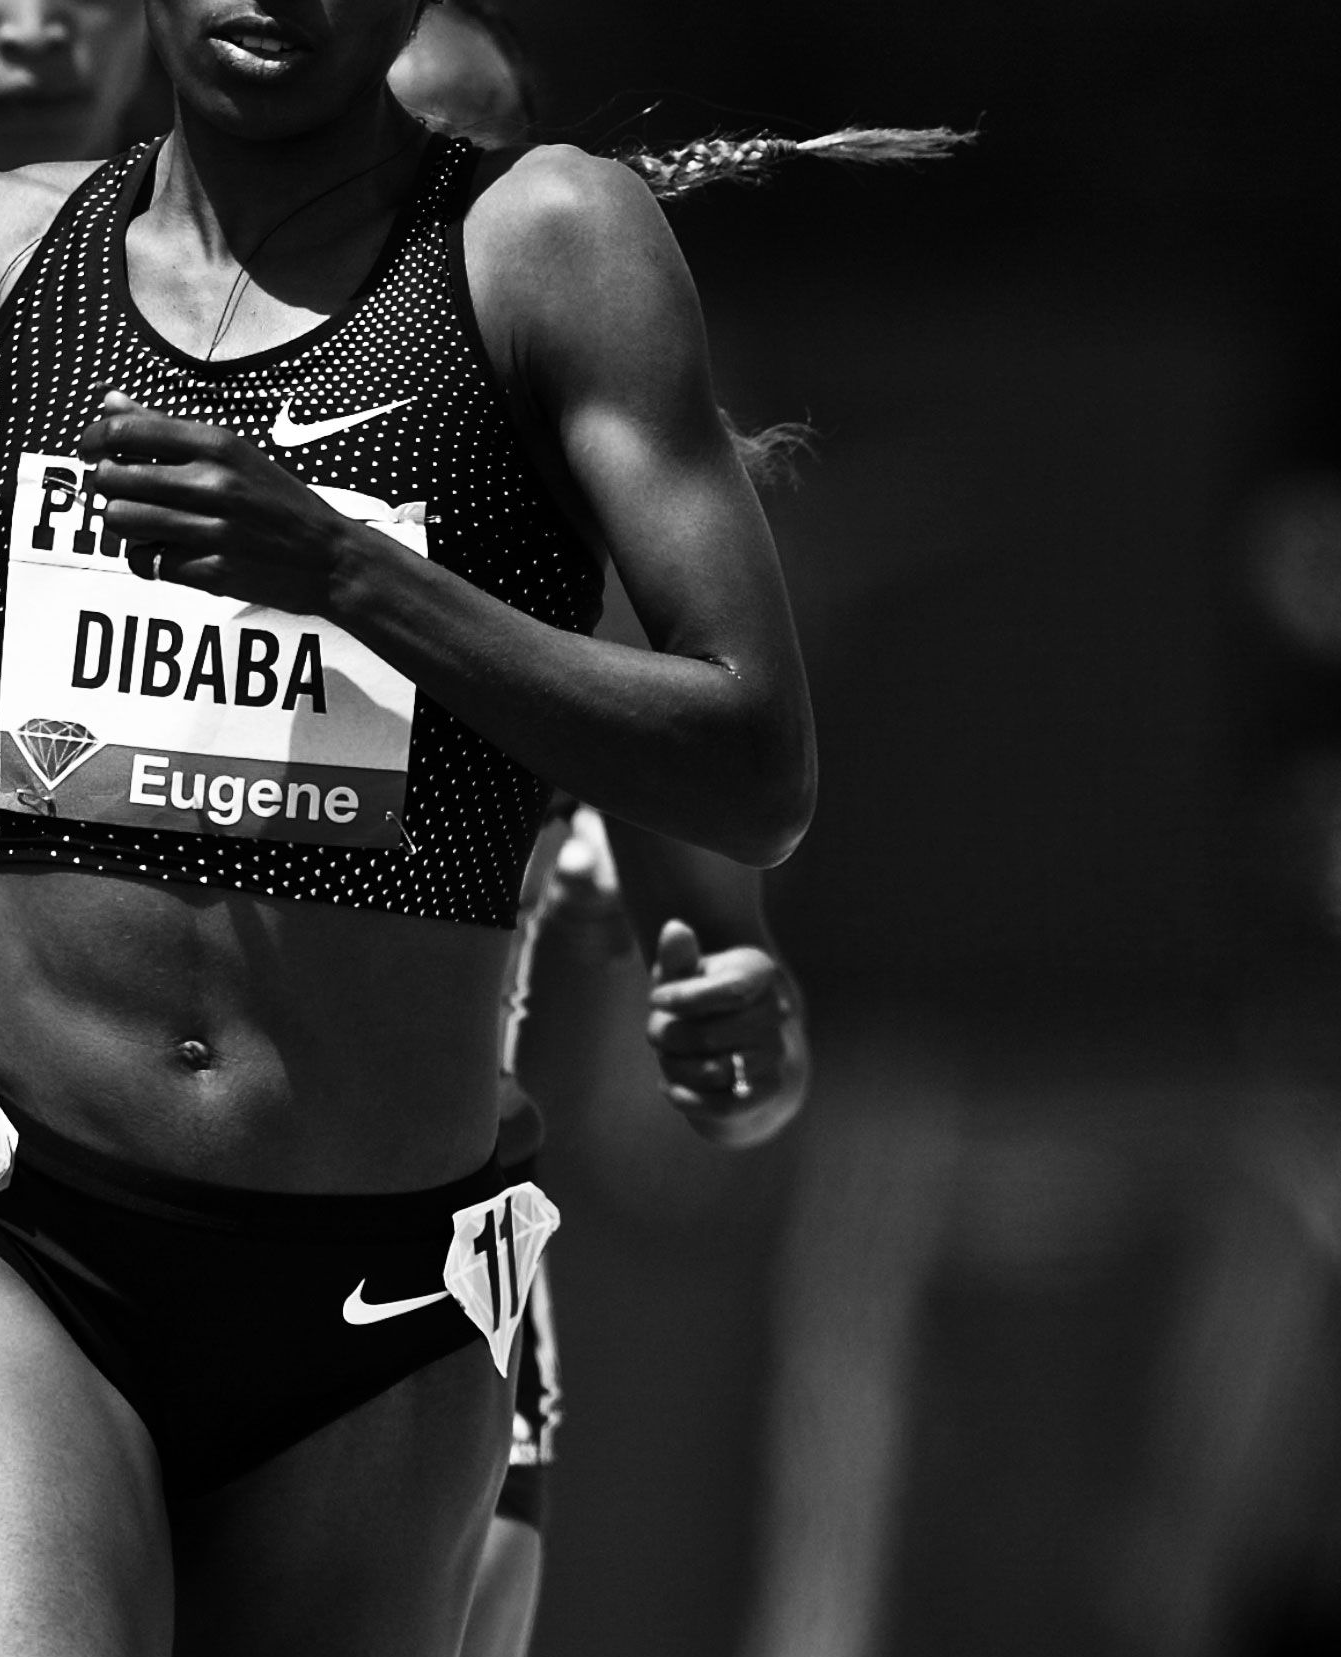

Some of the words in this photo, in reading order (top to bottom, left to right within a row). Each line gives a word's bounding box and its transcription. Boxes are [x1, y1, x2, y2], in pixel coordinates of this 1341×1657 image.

[71, 609, 328, 715] DIBABA
[128, 752, 360, 826] Eugene
[473, 1194, 520, 1334] 11
